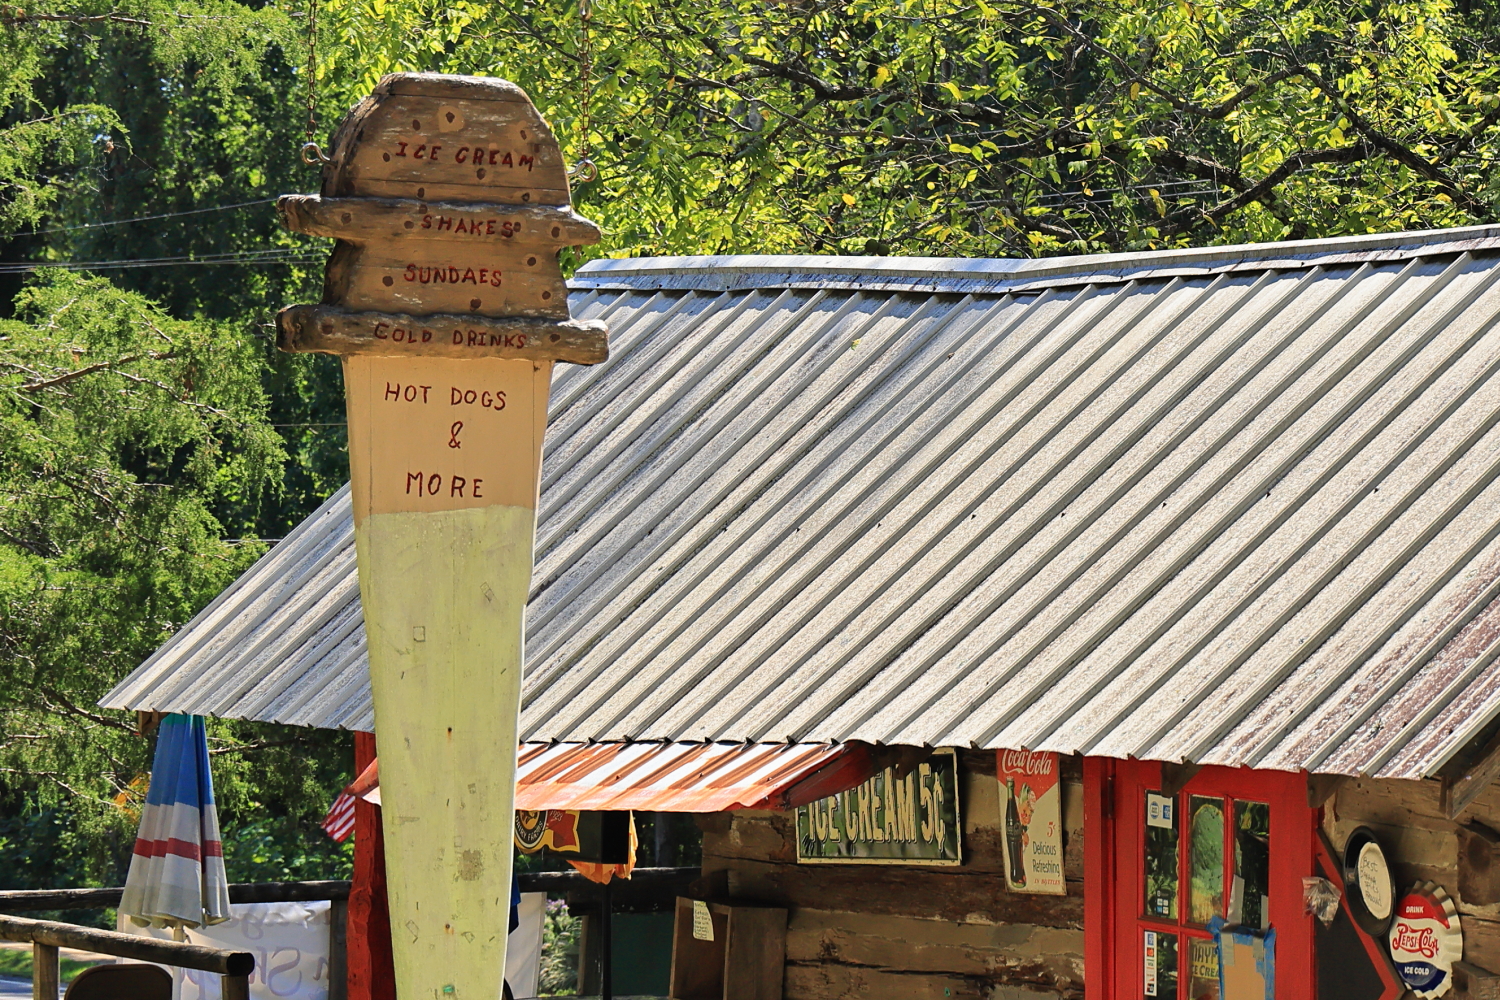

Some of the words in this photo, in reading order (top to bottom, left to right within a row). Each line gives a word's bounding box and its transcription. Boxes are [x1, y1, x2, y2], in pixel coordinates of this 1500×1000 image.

[395, 141, 440, 161] ICE
[455, 146, 535, 172] CREAM
[420, 213, 515, 239] SHAKES
[403, 263, 502, 288] SUNDAES
[373, 322, 433, 345] COLD
[453, 330, 528, 350] DRINKS
[384, 381, 433, 405] HOT
[450, 386, 507, 412] DOGS
[448, 421, 465, 450] &
[405, 471, 484, 499] MORE
[1032, 840, 1057, 856] Delicious
[1032, 858, 1060, 878] Refreshing
[1405, 905, 1425, 914] DRINK
[1404, 965, 1414, 974] ICE
[1413, 966, 1430, 976] COLD
